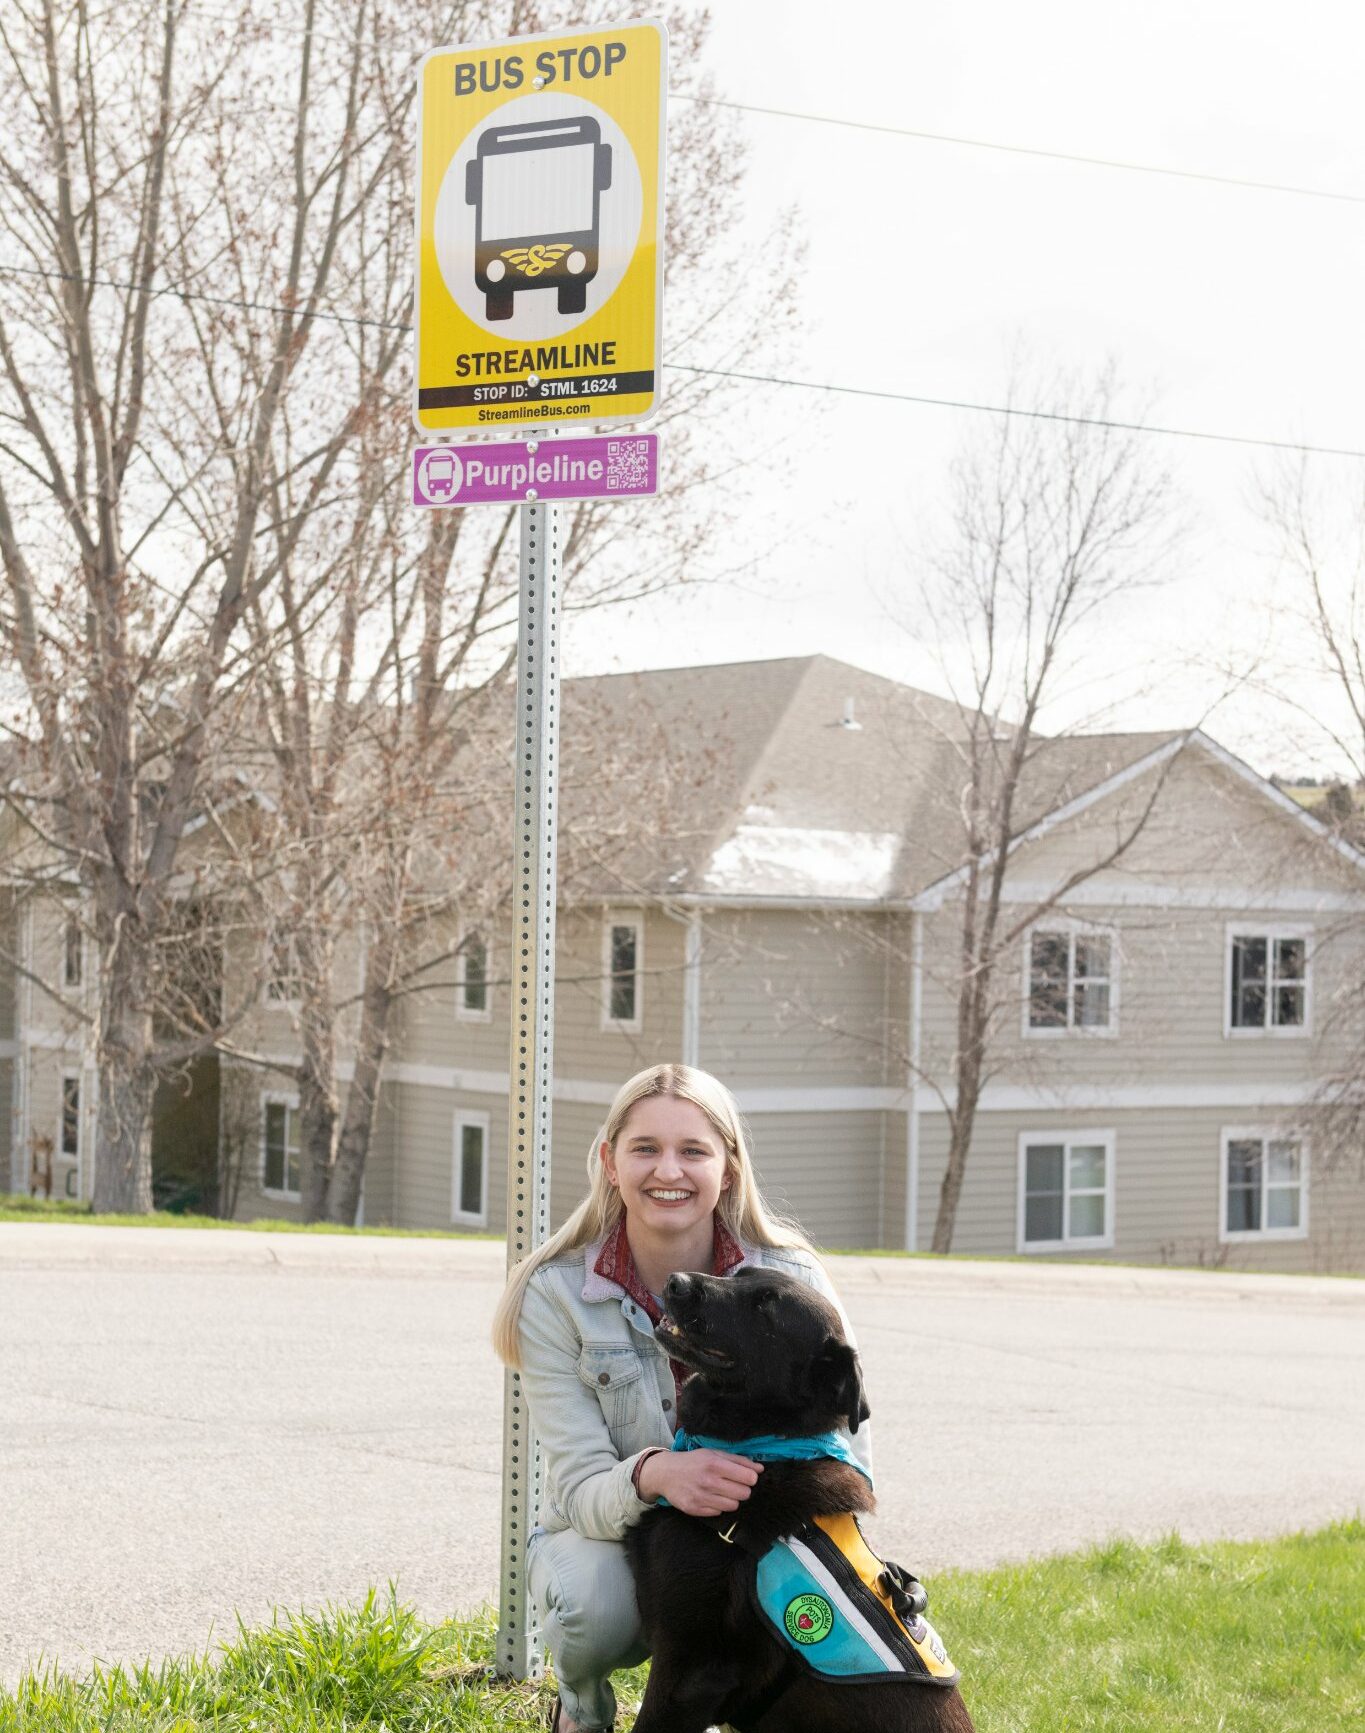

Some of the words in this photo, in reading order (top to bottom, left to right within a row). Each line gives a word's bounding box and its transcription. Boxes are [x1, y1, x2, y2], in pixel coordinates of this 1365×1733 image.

[455, 56, 524, 96] BUS
[535, 42, 627, 84] STOP
[455, 341, 617, 378] STREAMLINE
[473, 386, 507, 401] STOP
[511, 384, 528, 398] ID:
[540, 381, 577, 396] STML
[581, 378, 617, 394] 1624
[478, 404, 591, 421] StreamlineBus.com
[465, 455, 604, 490] Purpleline
[787, 1610, 799, 1637] SERVICE
[801, 1597, 830, 1629] DYSAUTONOMIA
[806, 1606, 821, 1623] POTS
